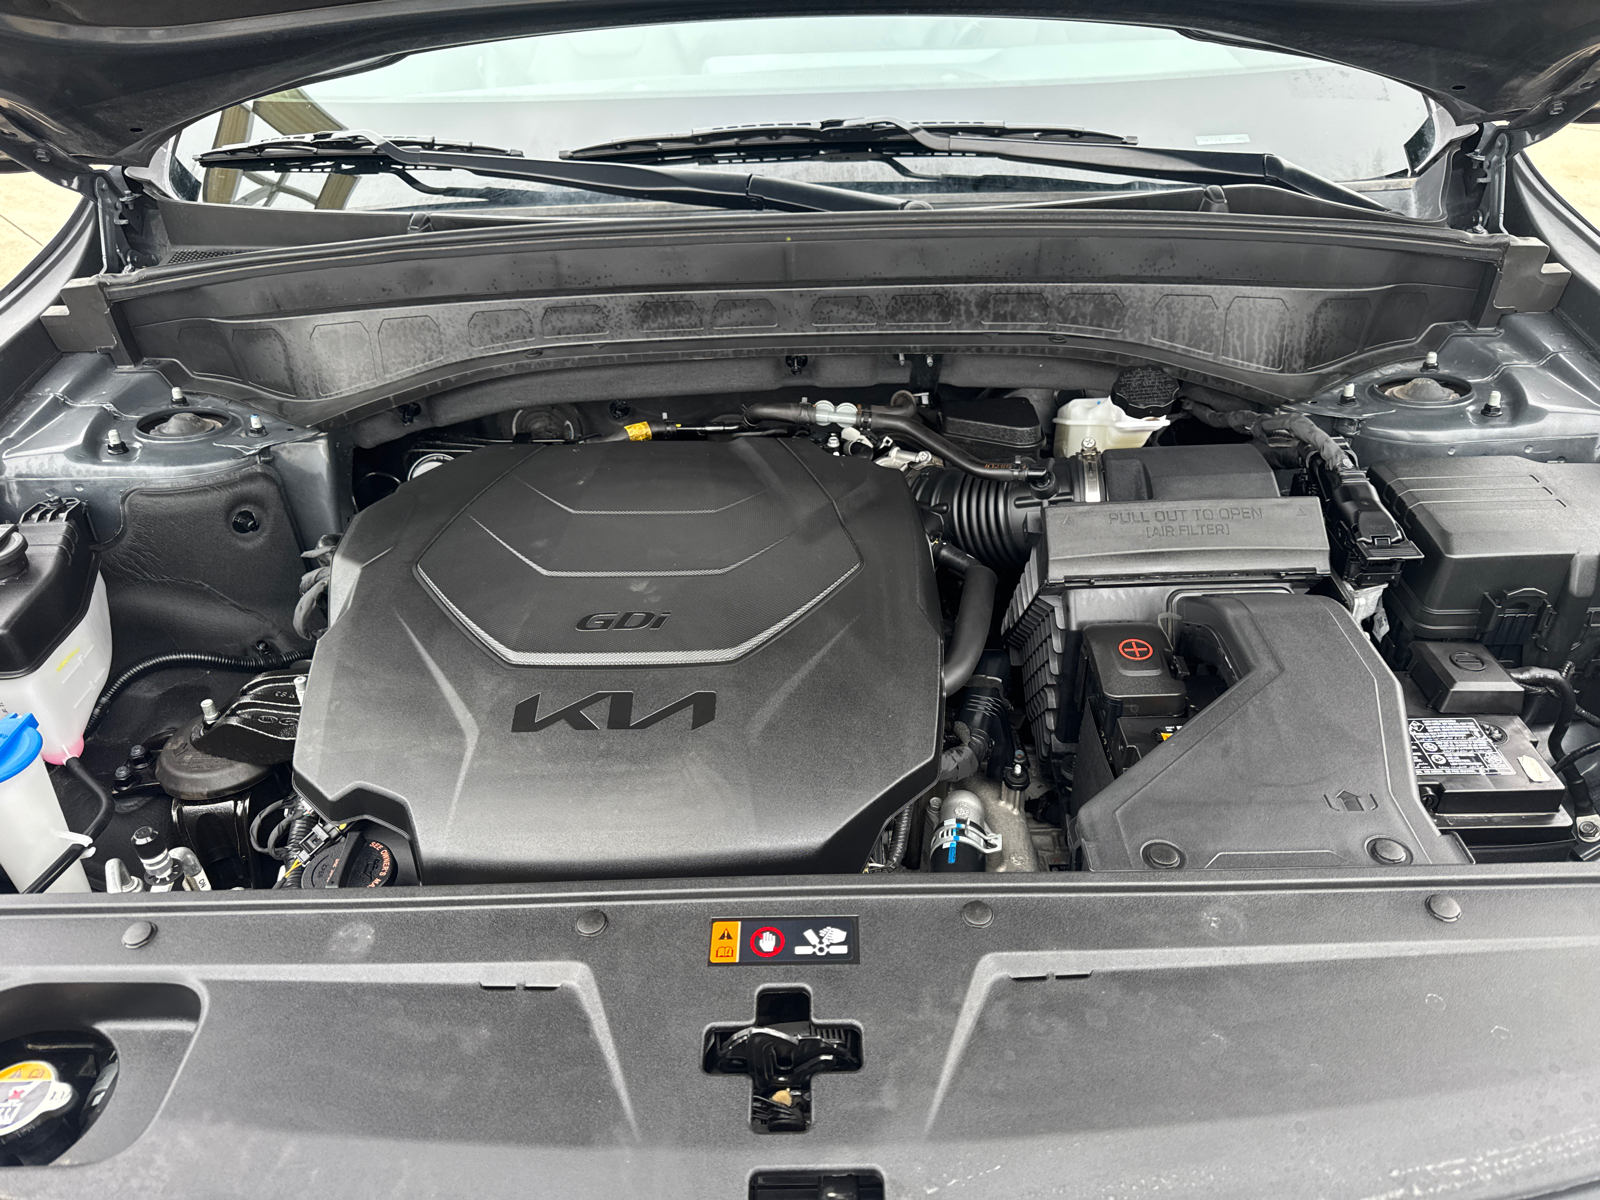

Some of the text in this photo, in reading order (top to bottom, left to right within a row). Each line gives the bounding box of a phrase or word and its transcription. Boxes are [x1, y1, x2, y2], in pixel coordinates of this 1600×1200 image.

[1109, 506, 1263, 525] PULL OUT TO OPEN
[575, 611, 671, 632] GDi
[511, 690, 717, 733] KIA
[369, 841, 383, 850] SEE
